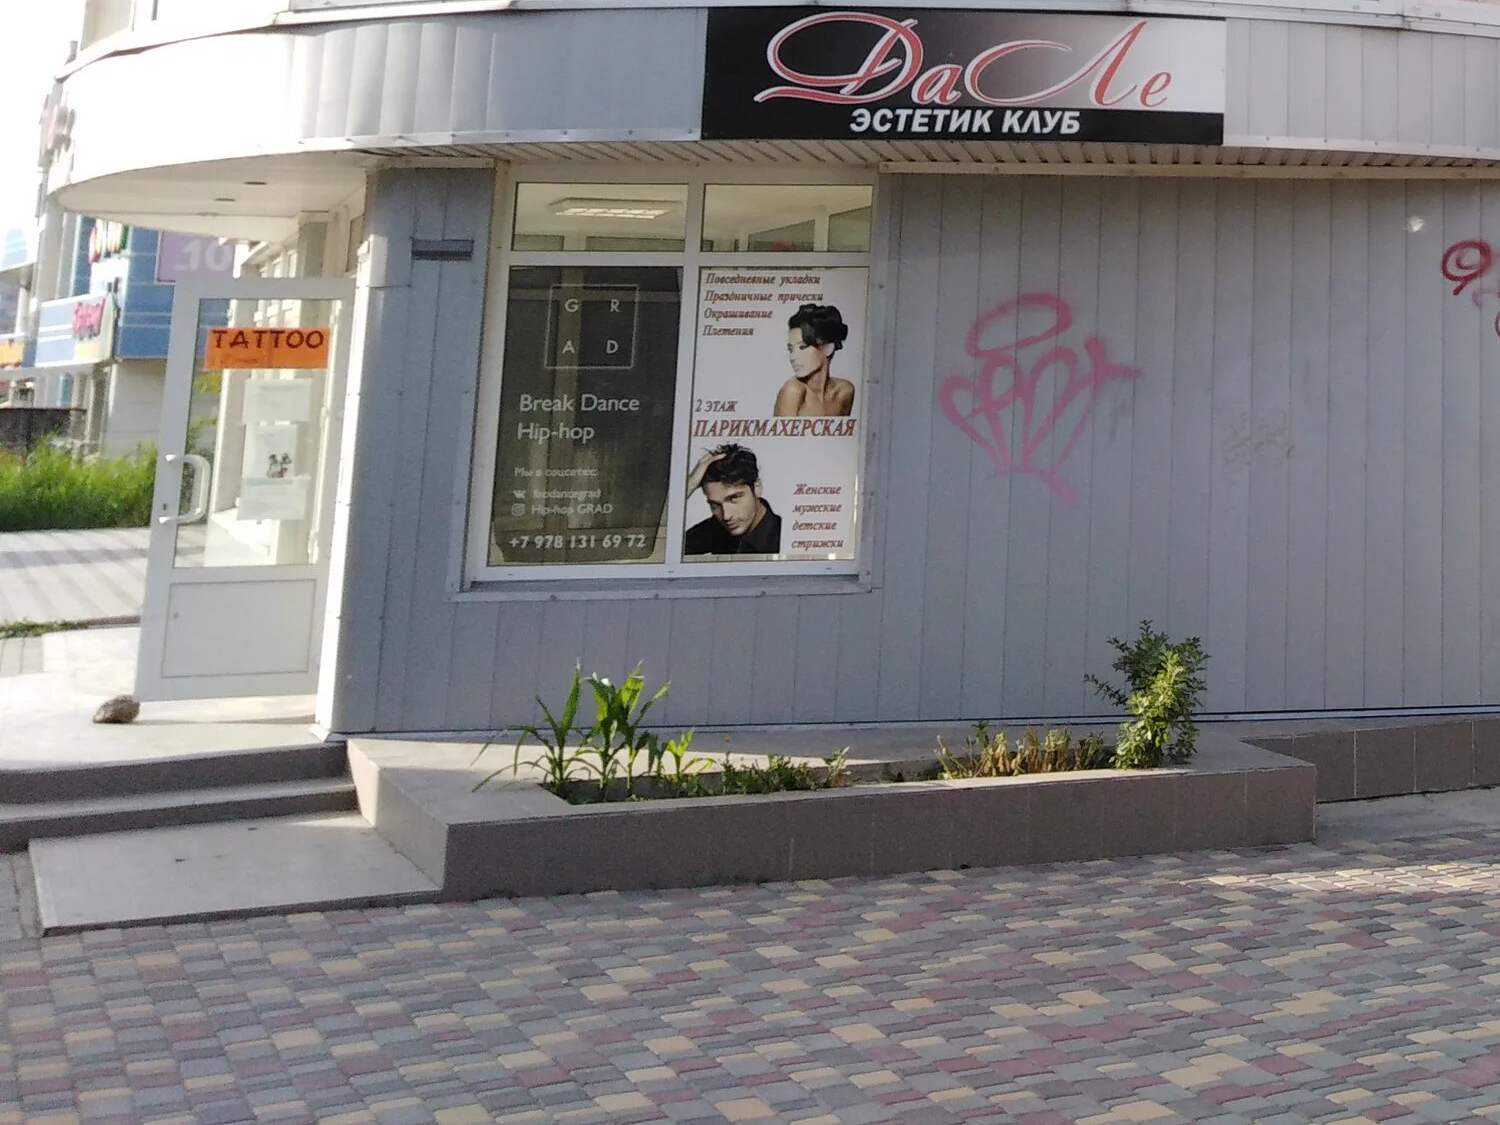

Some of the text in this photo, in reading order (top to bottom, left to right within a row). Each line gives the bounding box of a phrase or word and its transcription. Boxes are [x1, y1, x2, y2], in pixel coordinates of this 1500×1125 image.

[849, 108, 1081, 135] ЭСТЕТИК КЛУБ
[706, 273, 821, 286] Повседневные укладки
[704, 290, 823, 304] Праздничные прически
[703, 307, 774, 321] Окрашивание
[702, 325, 754, 336] Плетения
[212, 330, 325, 349] TATTOO
[519, 393, 640, 412] Break Dance
[695, 399, 703, 413] 2
[517, 422, 595, 445] Hip-hop
[693, 419, 857, 437] ПАРИКМАХЕРСКАЯ
[793, 483, 842, 495] Женские
[577, 503, 613, 515] GRAD
[792, 503, 842, 513] мужские
[792, 520, 837, 531] детские
[509, 534, 647, 549] +7 978 131 69 72
[791, 539, 844, 551] стрижки
